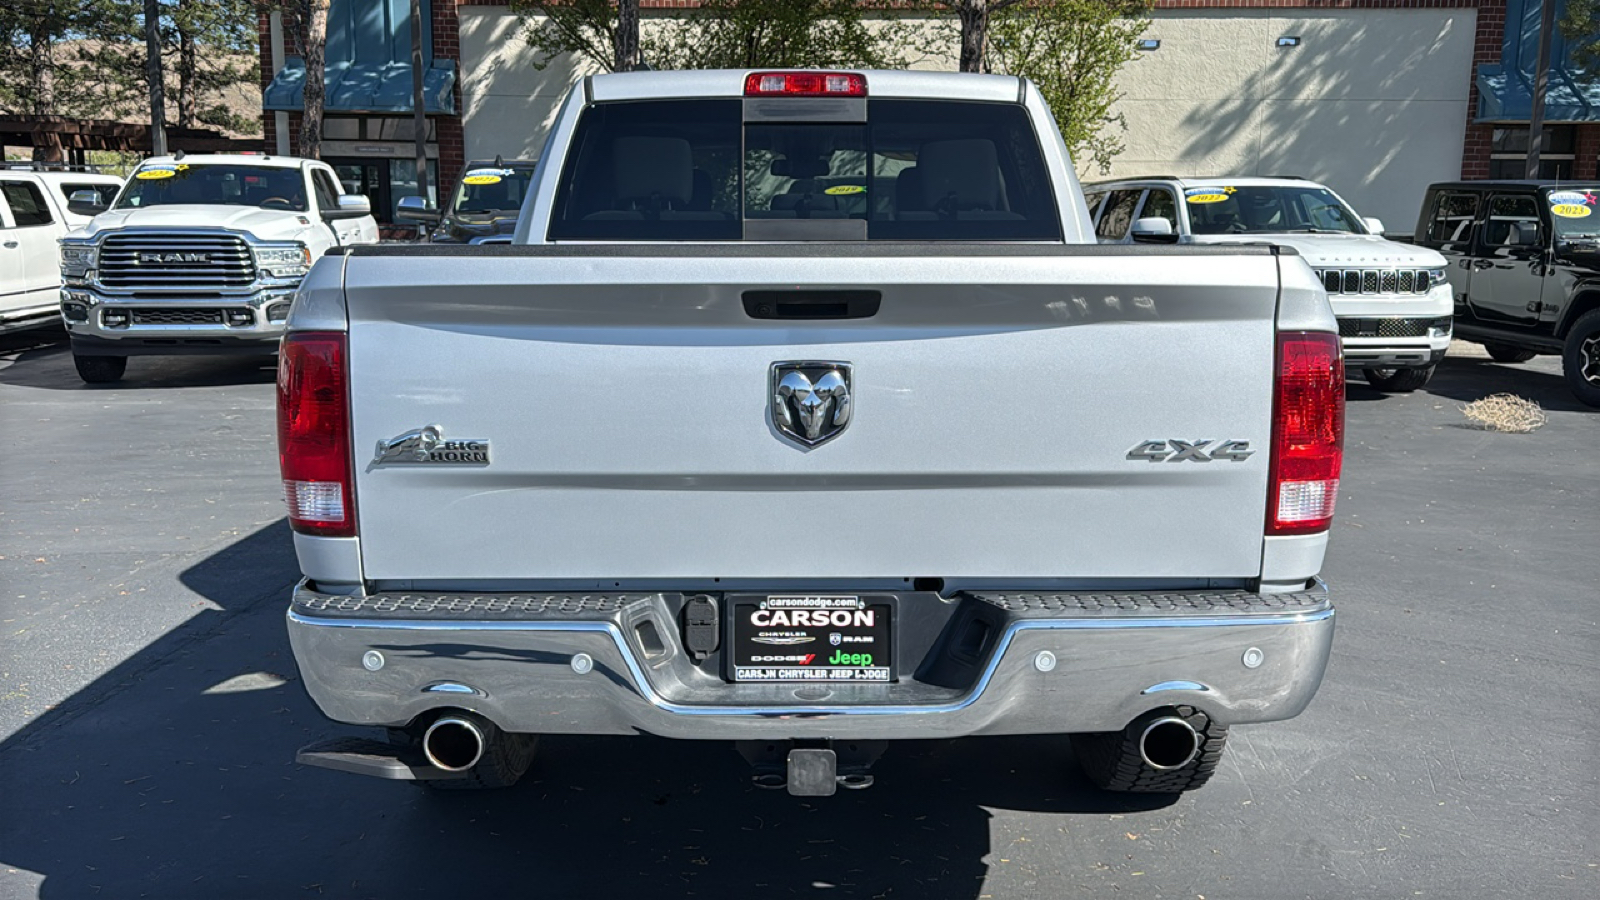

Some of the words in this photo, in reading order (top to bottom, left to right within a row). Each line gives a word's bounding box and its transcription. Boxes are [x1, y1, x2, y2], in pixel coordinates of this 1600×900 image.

[1559, 205, 1585, 215] 2023
[140, 253, 207, 263] RAM
[444, 440, 480, 451] BIG
[429, 451, 488, 462] HORN
[769, 596, 857, 608] carsondodge.com
[750, 609, 875, 627] CARSON
[829, 649, 873, 667] Jeep
[778, 669, 828, 680] CHRYSLER
[829, 669, 853, 680] JEEP
